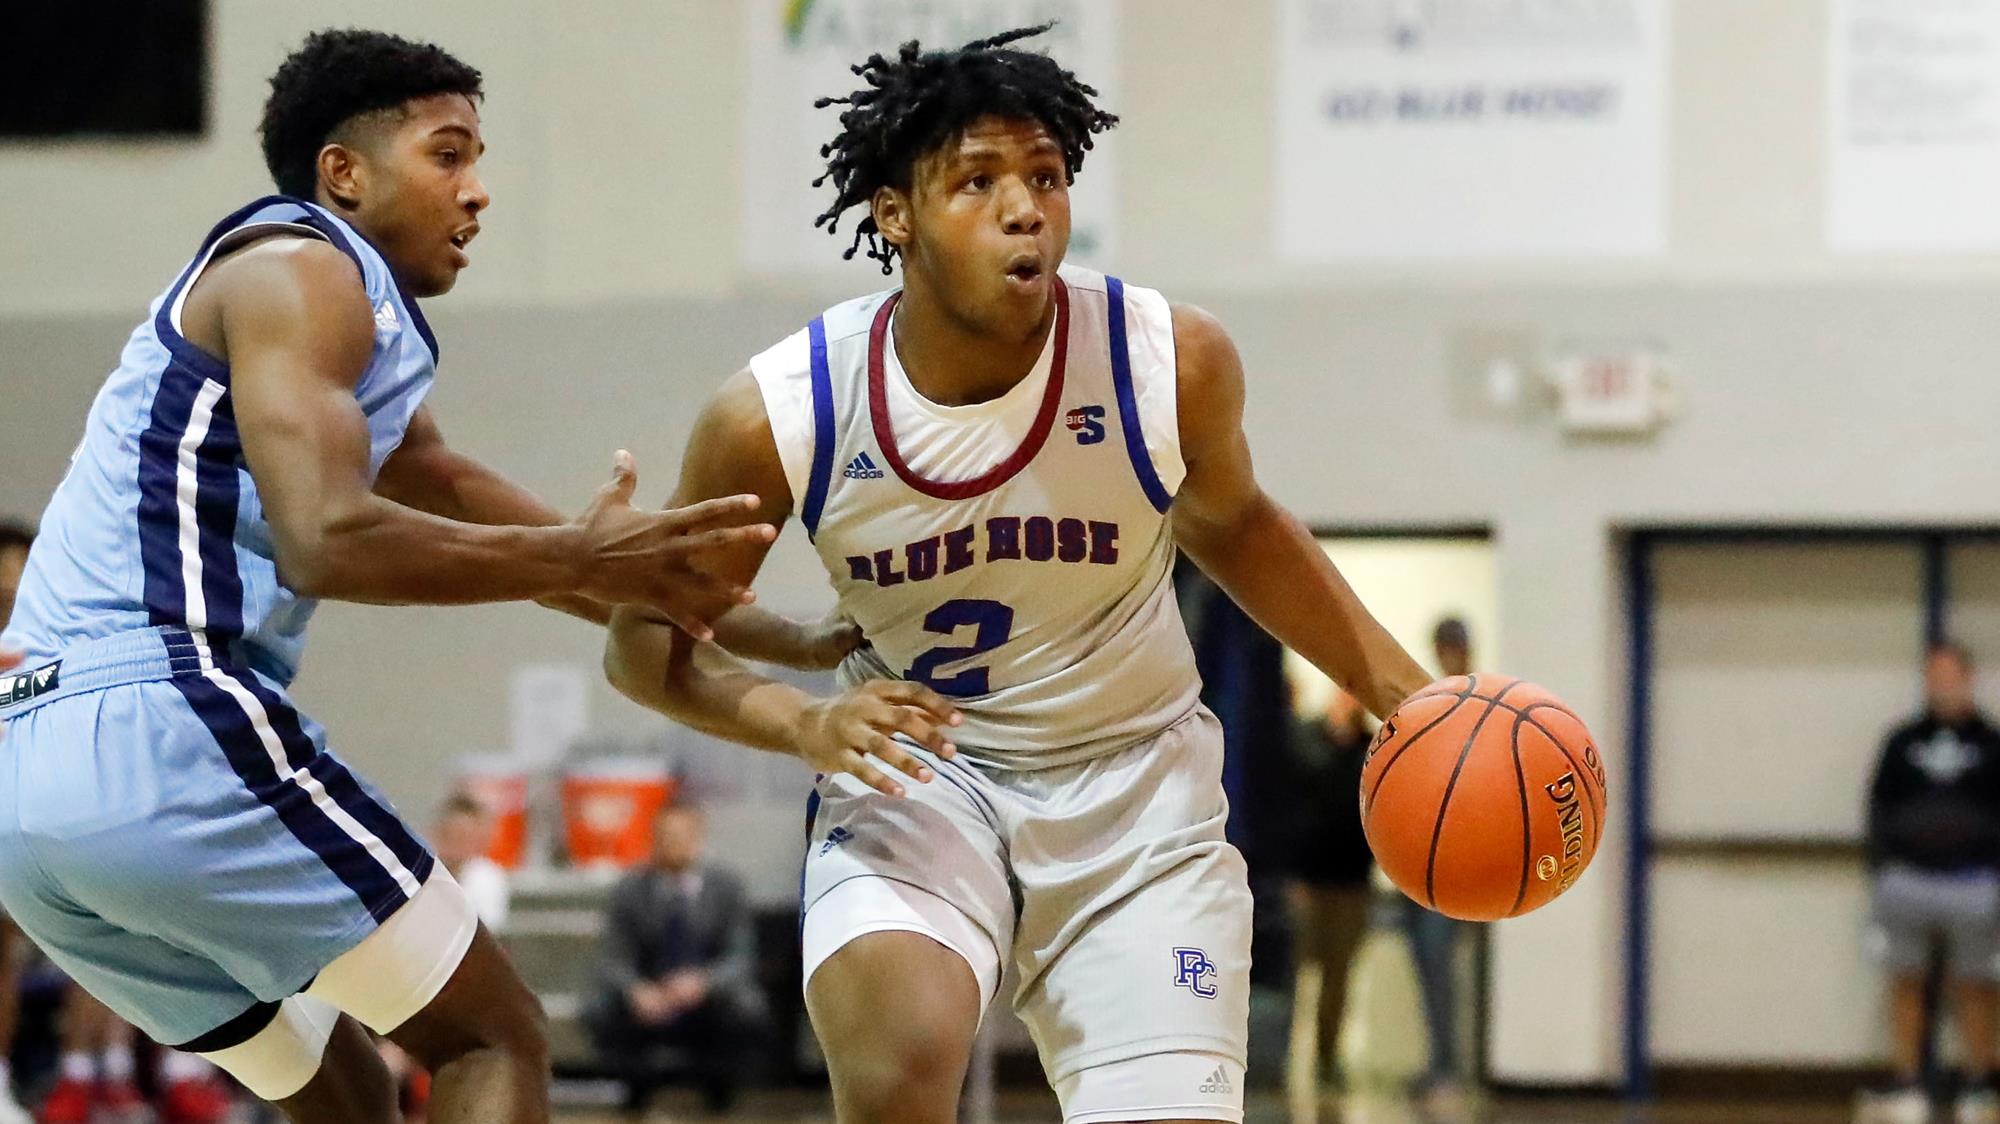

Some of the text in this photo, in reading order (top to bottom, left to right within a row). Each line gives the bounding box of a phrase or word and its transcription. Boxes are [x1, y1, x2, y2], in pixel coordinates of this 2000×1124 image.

[843, 468, 884, 480] adidas
[845, 516, 1120, 588] BLUE HOSE
[903, 598, 1014, 699] 2
[1173, 947, 1217, 999] PC
